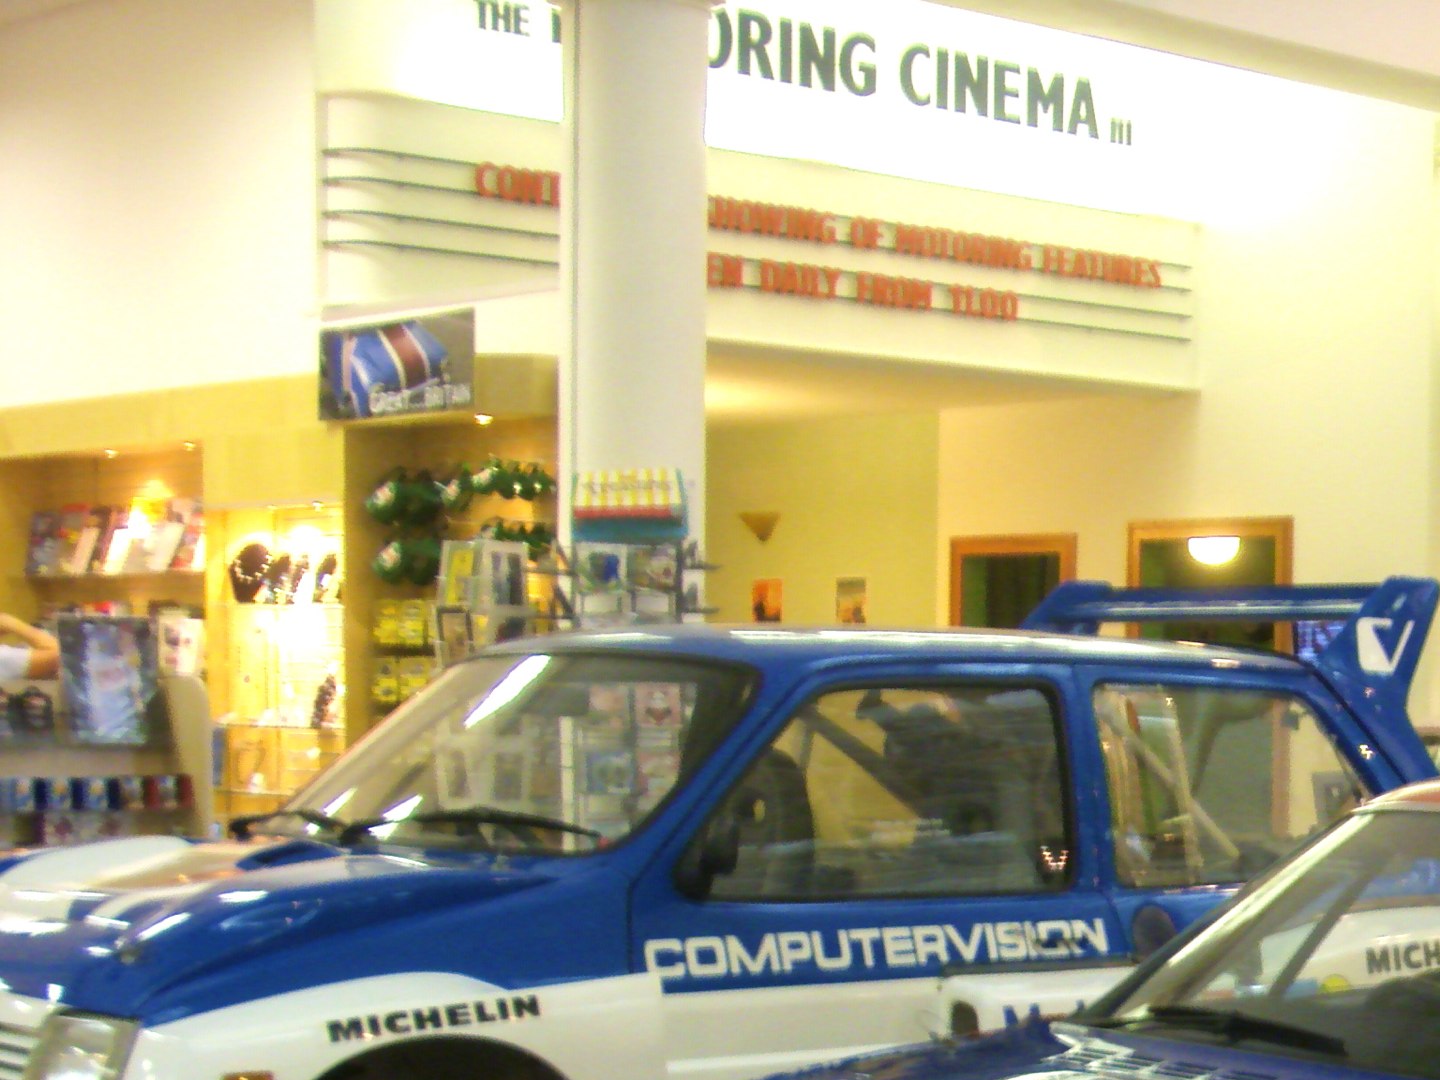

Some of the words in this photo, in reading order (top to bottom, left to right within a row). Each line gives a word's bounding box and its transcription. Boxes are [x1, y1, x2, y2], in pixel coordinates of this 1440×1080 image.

[474, 0, 530, 36] THE
[900, 44, 1099, 139] CINEMA
[849, 214, 885, 250] OF
[895, 222, 1033, 271] MOTORING
[1044, 243, 1163, 288] FEATURES
[760, 257, 840, 299] DAILY
[855, 270, 933, 311] FROM
[644, 918, 1109, 979] COMPUTERVISION
[326, 995, 540, 1042] MICHELIN
